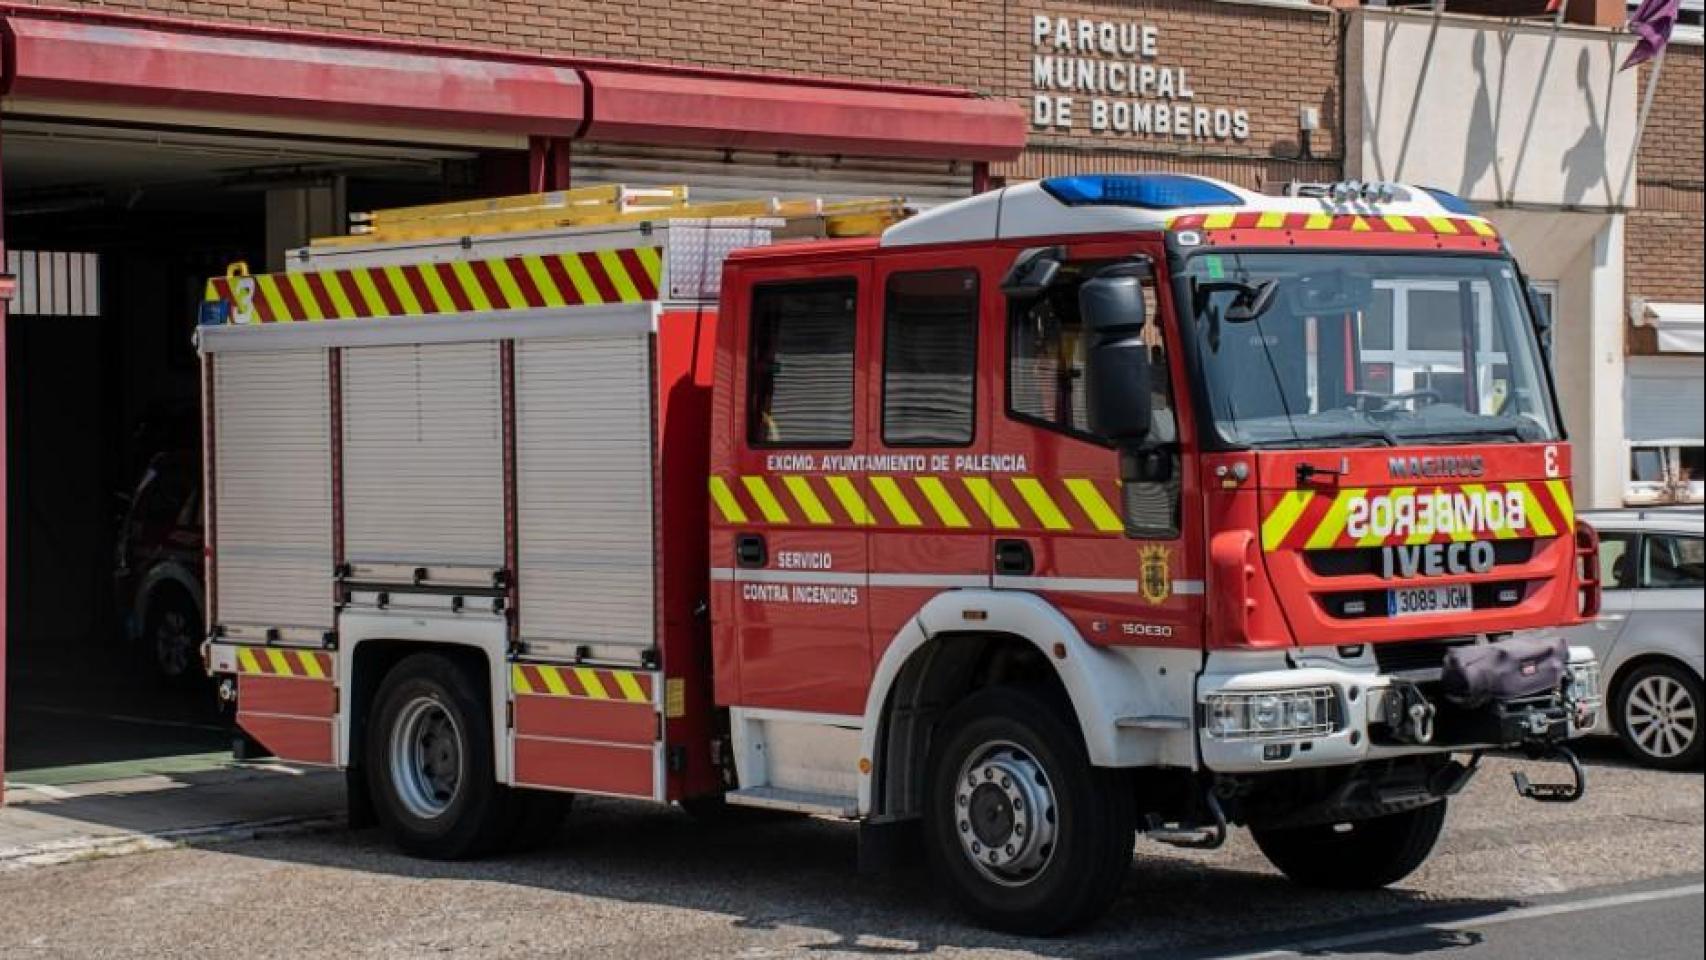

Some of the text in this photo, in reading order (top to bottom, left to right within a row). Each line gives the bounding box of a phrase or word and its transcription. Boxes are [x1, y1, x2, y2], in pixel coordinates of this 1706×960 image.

[1033, 16, 1158, 56] PARQUE
[1033, 55, 1194, 98] MUNICIPAL
[1033, 95, 1249, 139] DE BOMBEROS
[233, 277, 255, 323] 3
[821, 455, 925, 471] AYUNTAMIENTO
[931, 455, 950, 471] DE
[955, 455, 1027, 472] PALENCIA
[777, 552, 832, 569] SERVICIO
[1382, 540, 1496, 579] IVECO
[743, 584, 858, 605] CONTRA INCENDIOS
[1400, 589, 1438, 612] 3089
